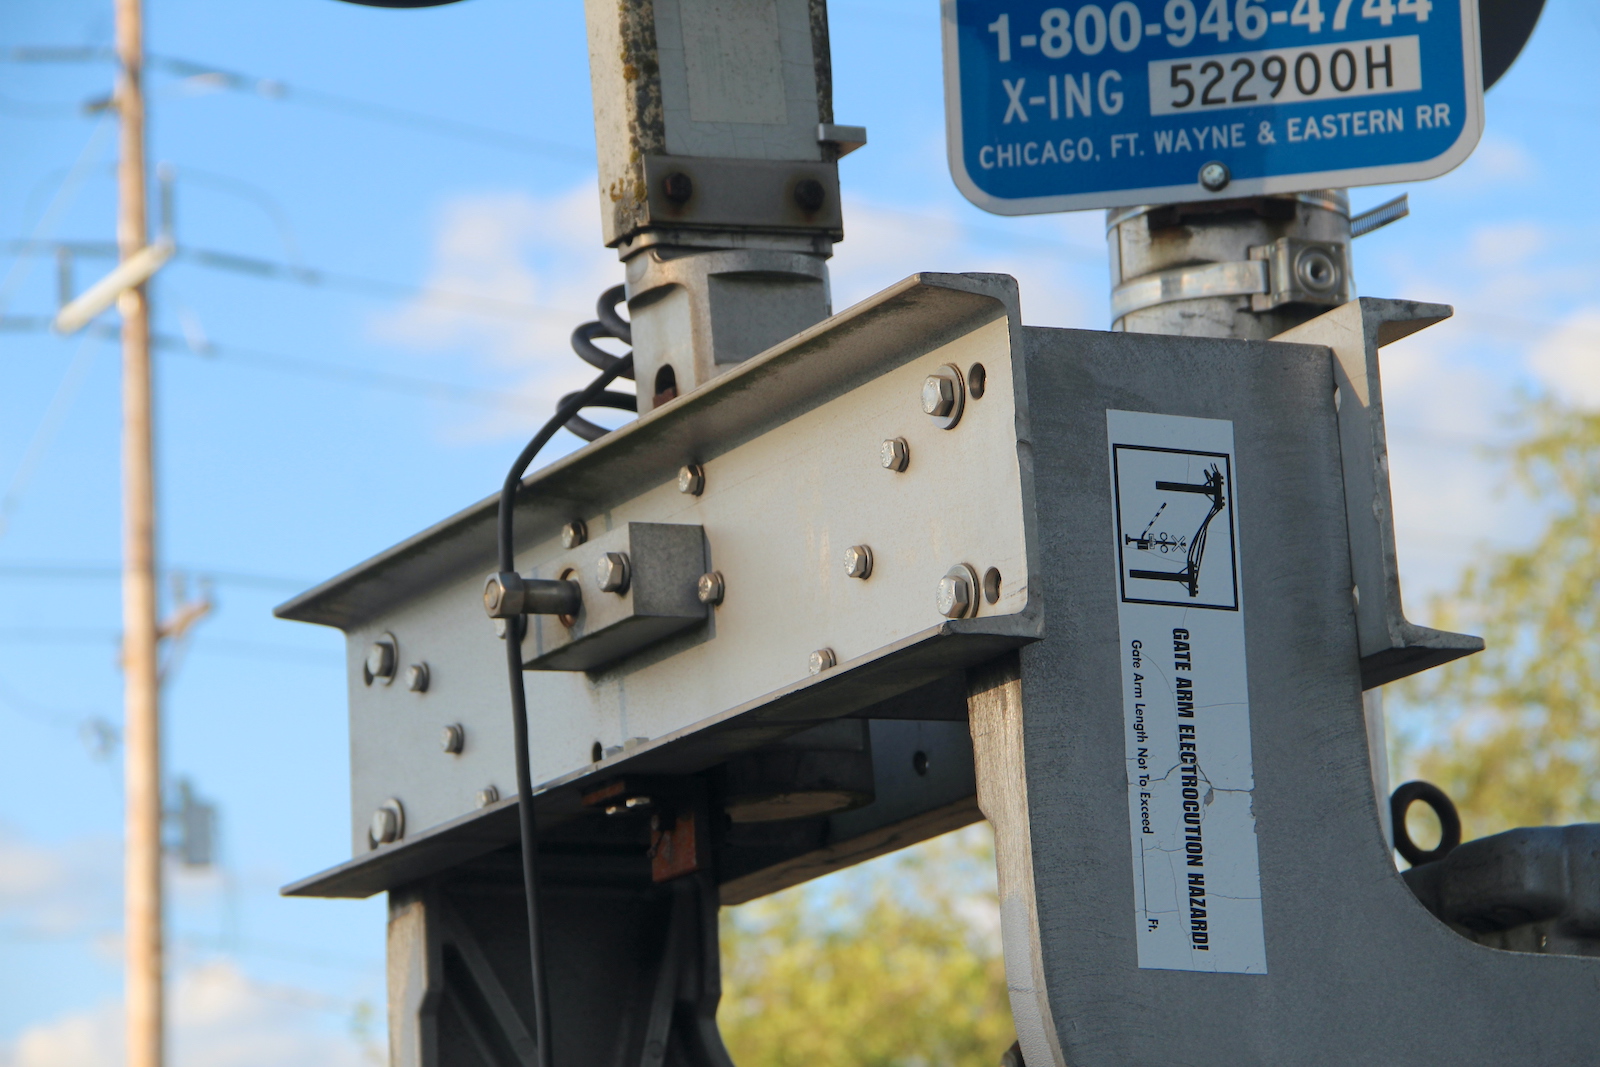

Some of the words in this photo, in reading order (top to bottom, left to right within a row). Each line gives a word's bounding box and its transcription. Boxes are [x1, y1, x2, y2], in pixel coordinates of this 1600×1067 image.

[1002, 69, 1125, 124] X-ING
[1170, 44, 1393, 109] 522900H
[1111, 133, 1145, 158] FT.
[1154, 123, 1246, 154] WAYNE
[1257, 121, 1277, 145] &
[1287, 108, 1404, 142] EASTERN
[1416, 103, 1451, 129] RR
[1131, 639, 1143, 669] Gate
[1172, 627, 1191, 671] GATE
[1133, 672, 1144, 699] Arm
[1175, 676, 1194, 718] ARM
[1133, 703, 1149, 743] Length
[1137, 747, 1149, 770] Not
[1138, 773, 1150, 787] To
[1178, 724, 1204, 867] ELECTROCUTION
[1139, 792, 1154, 834] Exceed
[1147, 918, 1159, 933] Ft.
[1187, 873, 1209, 951] HAZARD!
